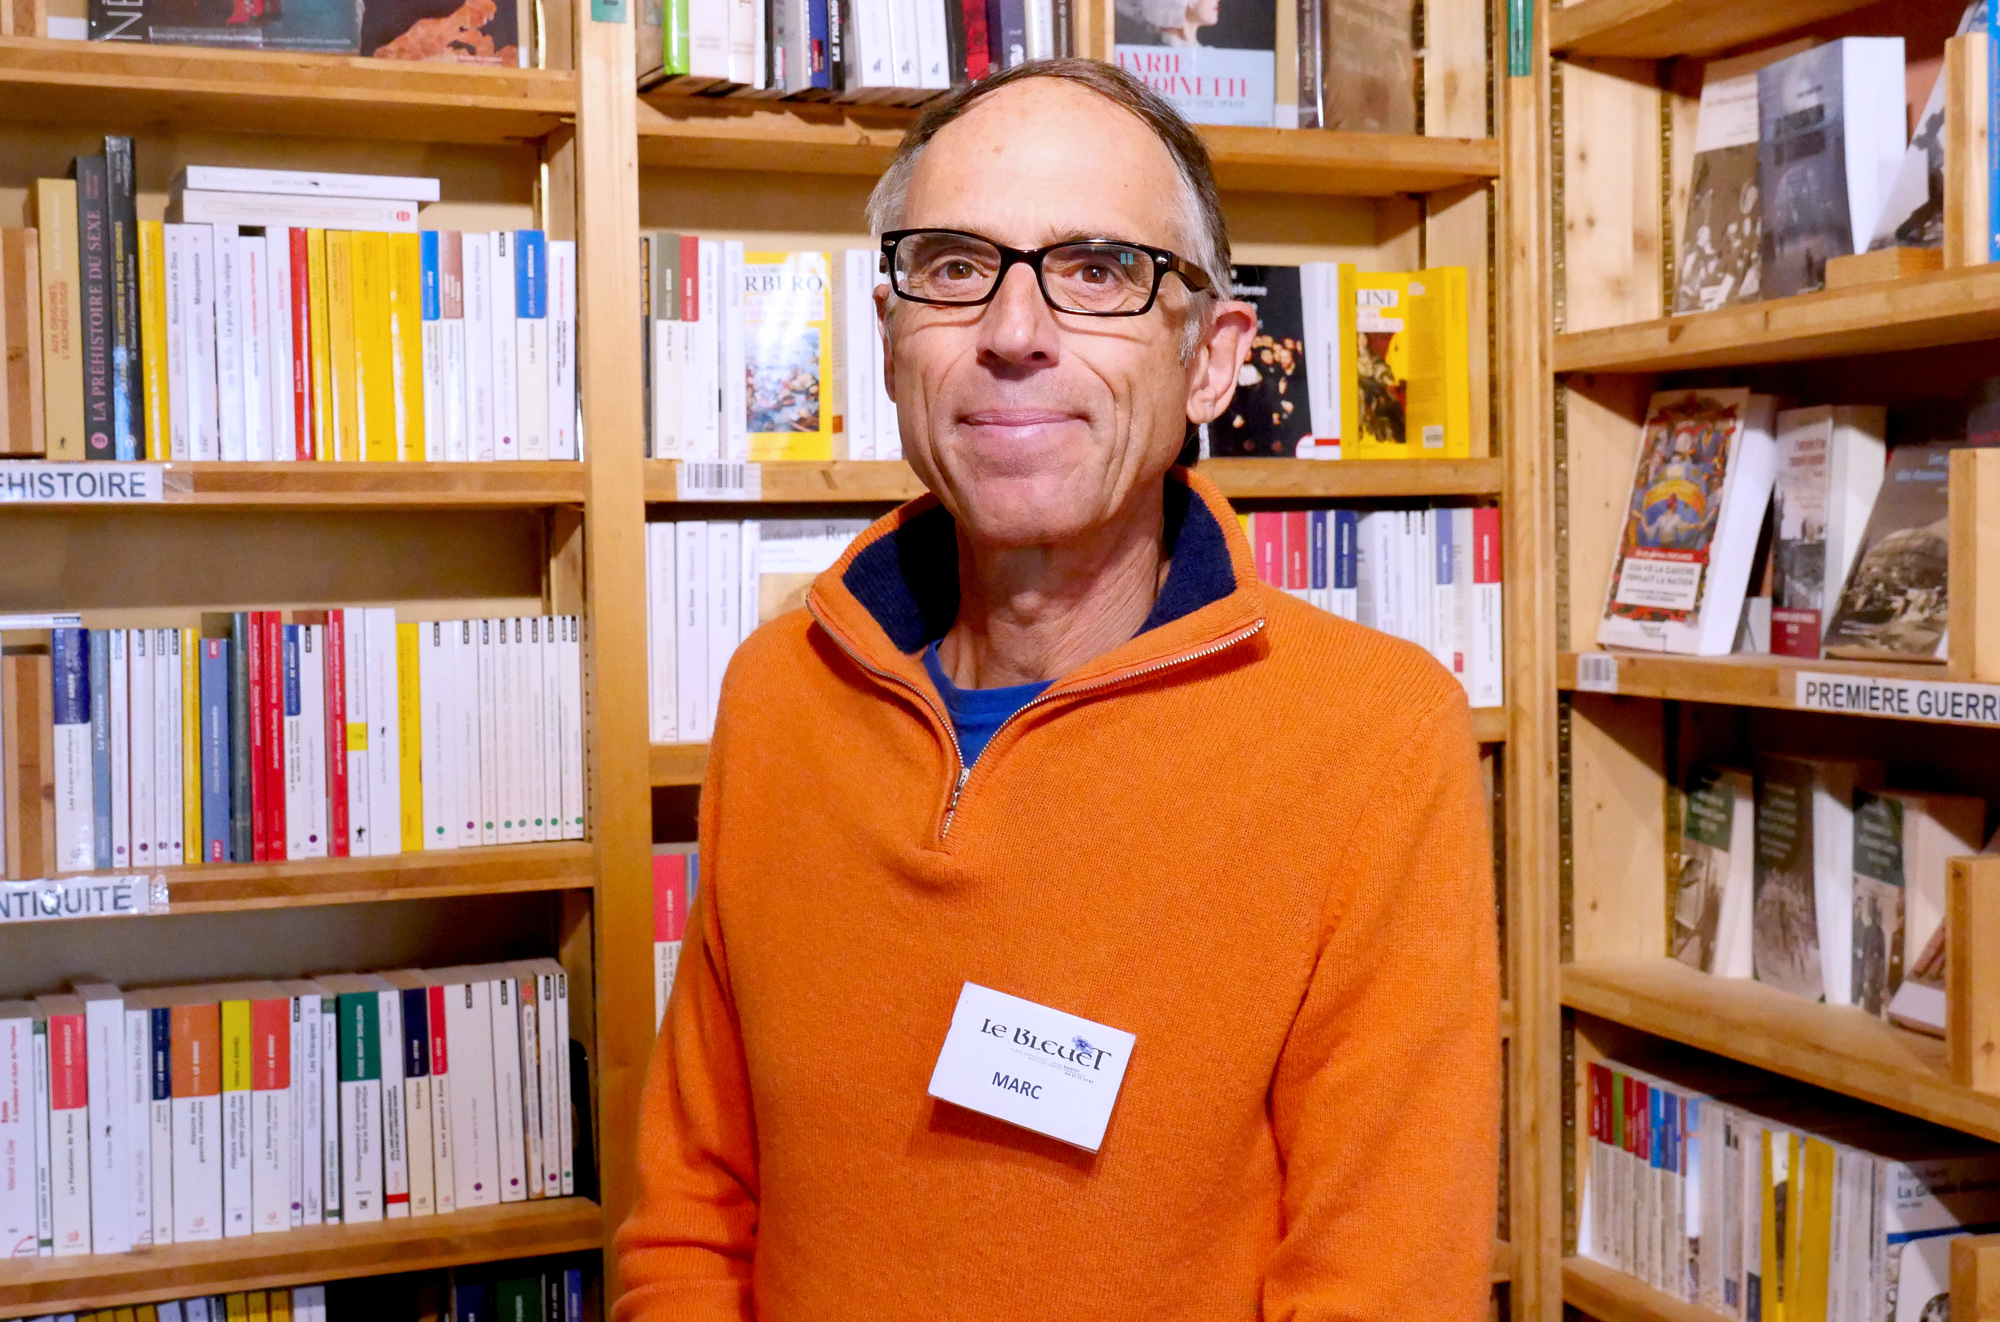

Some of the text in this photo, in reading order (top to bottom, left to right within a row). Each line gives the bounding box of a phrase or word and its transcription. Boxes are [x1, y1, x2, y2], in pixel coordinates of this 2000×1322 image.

[832, 50, 841, 62] LE
[86, 209, 102, 251] SEXE
[87, 255, 103, 280] DU
[86, 285, 106, 396] PRÉHISTOIRE
[92, 401, 107, 422] LA
[1805, 678, 2000, 721] PREMIÈRE GUERR
[991, 1071, 1042, 1100] MARC
